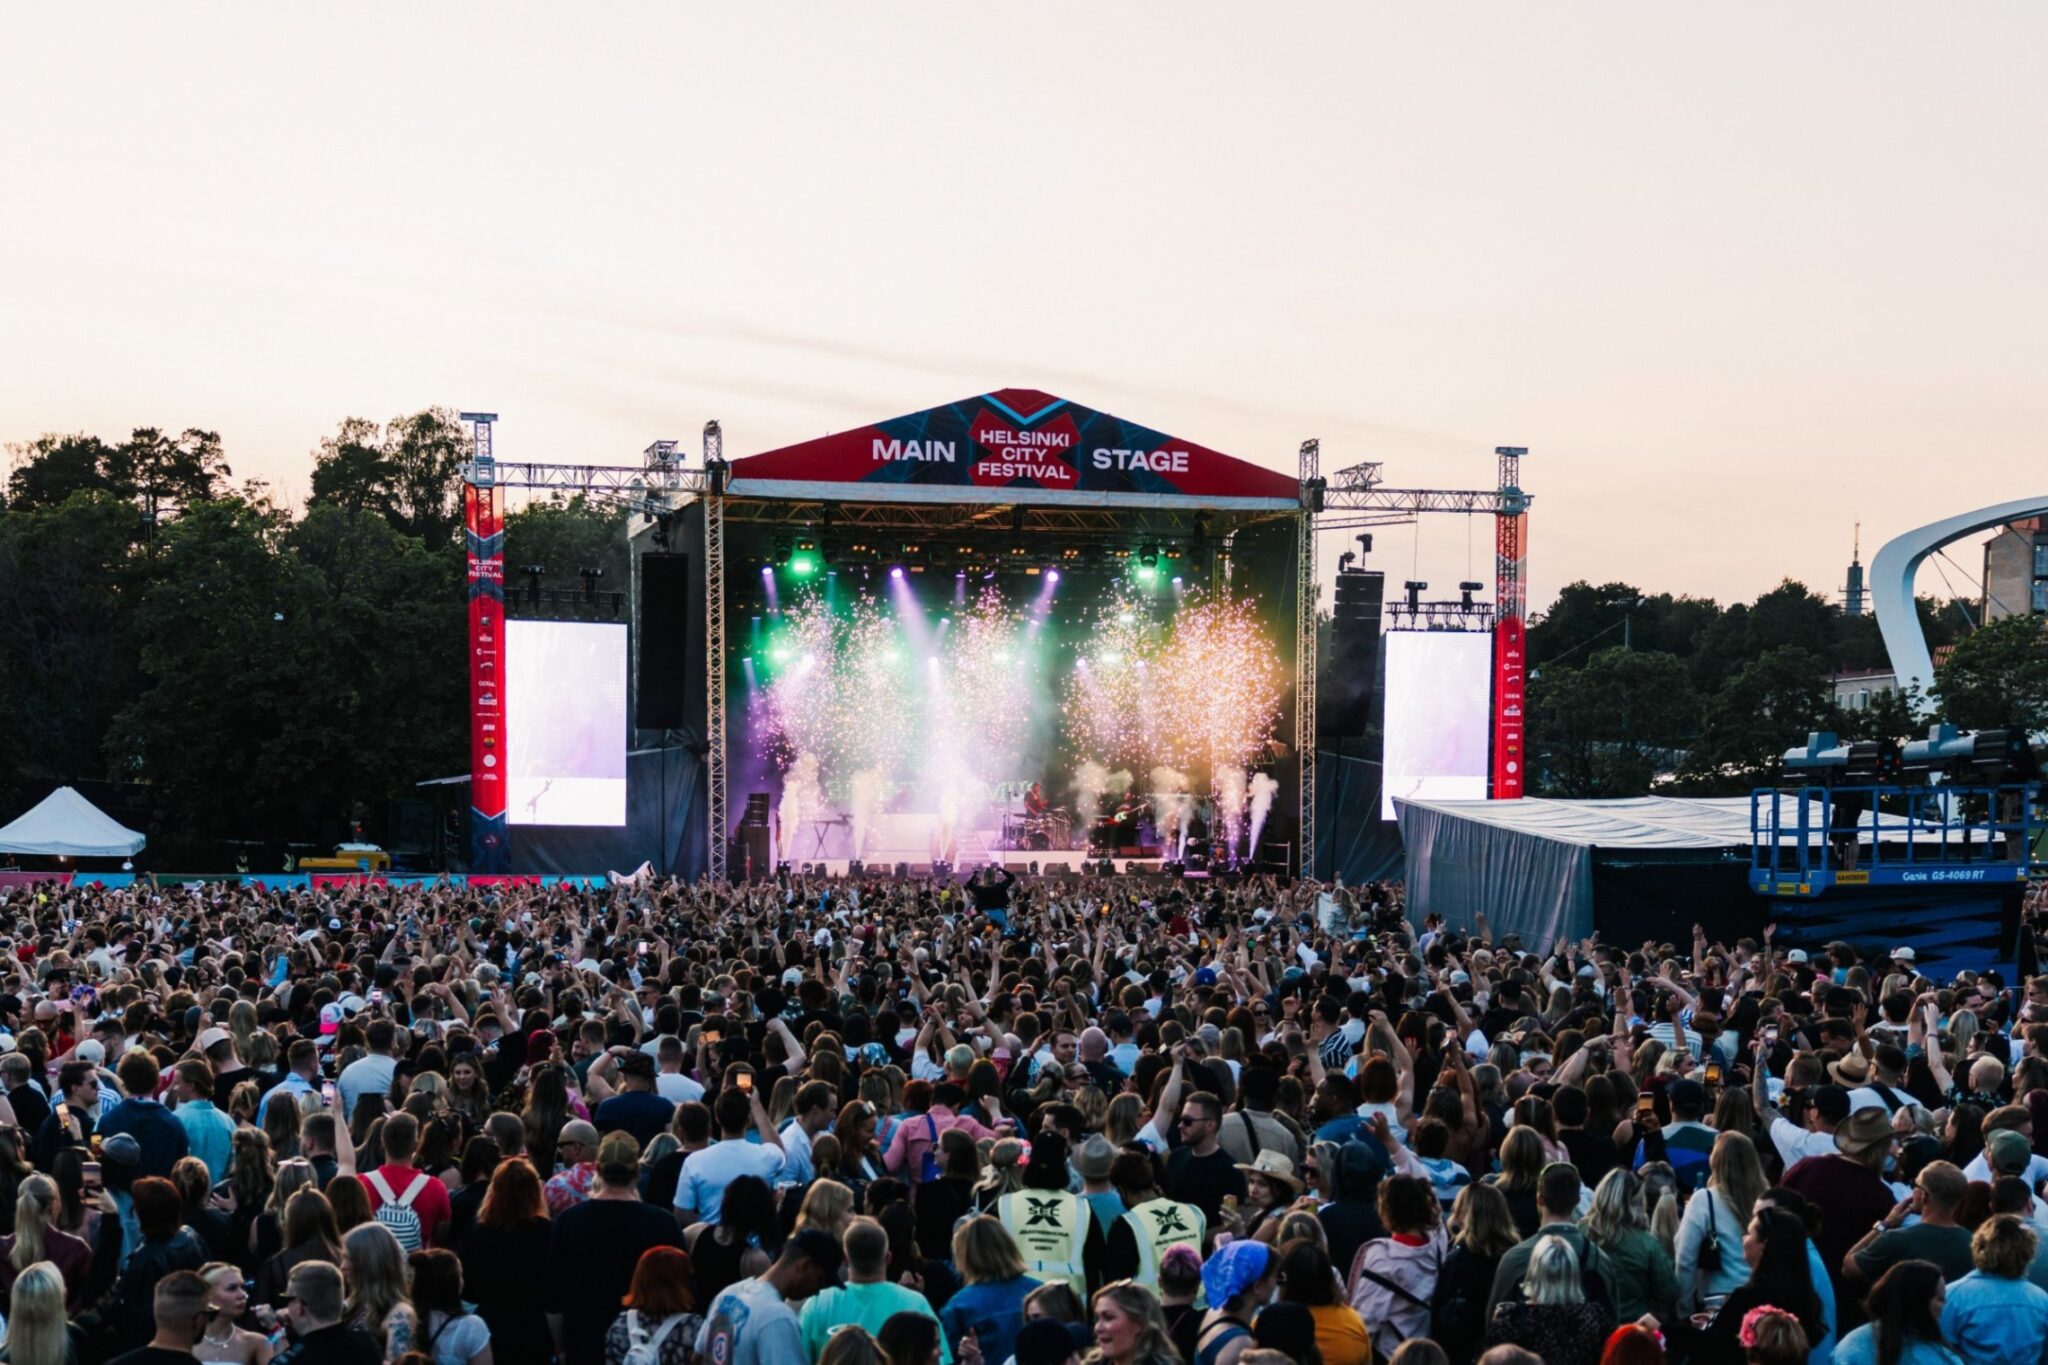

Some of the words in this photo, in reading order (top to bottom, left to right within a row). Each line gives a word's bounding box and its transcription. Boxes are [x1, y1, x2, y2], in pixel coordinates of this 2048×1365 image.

[980, 429, 1070, 447] HELSINKI
[872, 439, 956, 463] MAIN
[1092, 447, 1190, 473] STAGE
[1001, 446, 1048, 462] CITY
[978, 461, 1071, 480] FESTIVAL
[1902, 871, 1928, 881] Genie
[1931, 869, 1972, 881] GS-4069
[1972, 869, 1985, 880] RT
